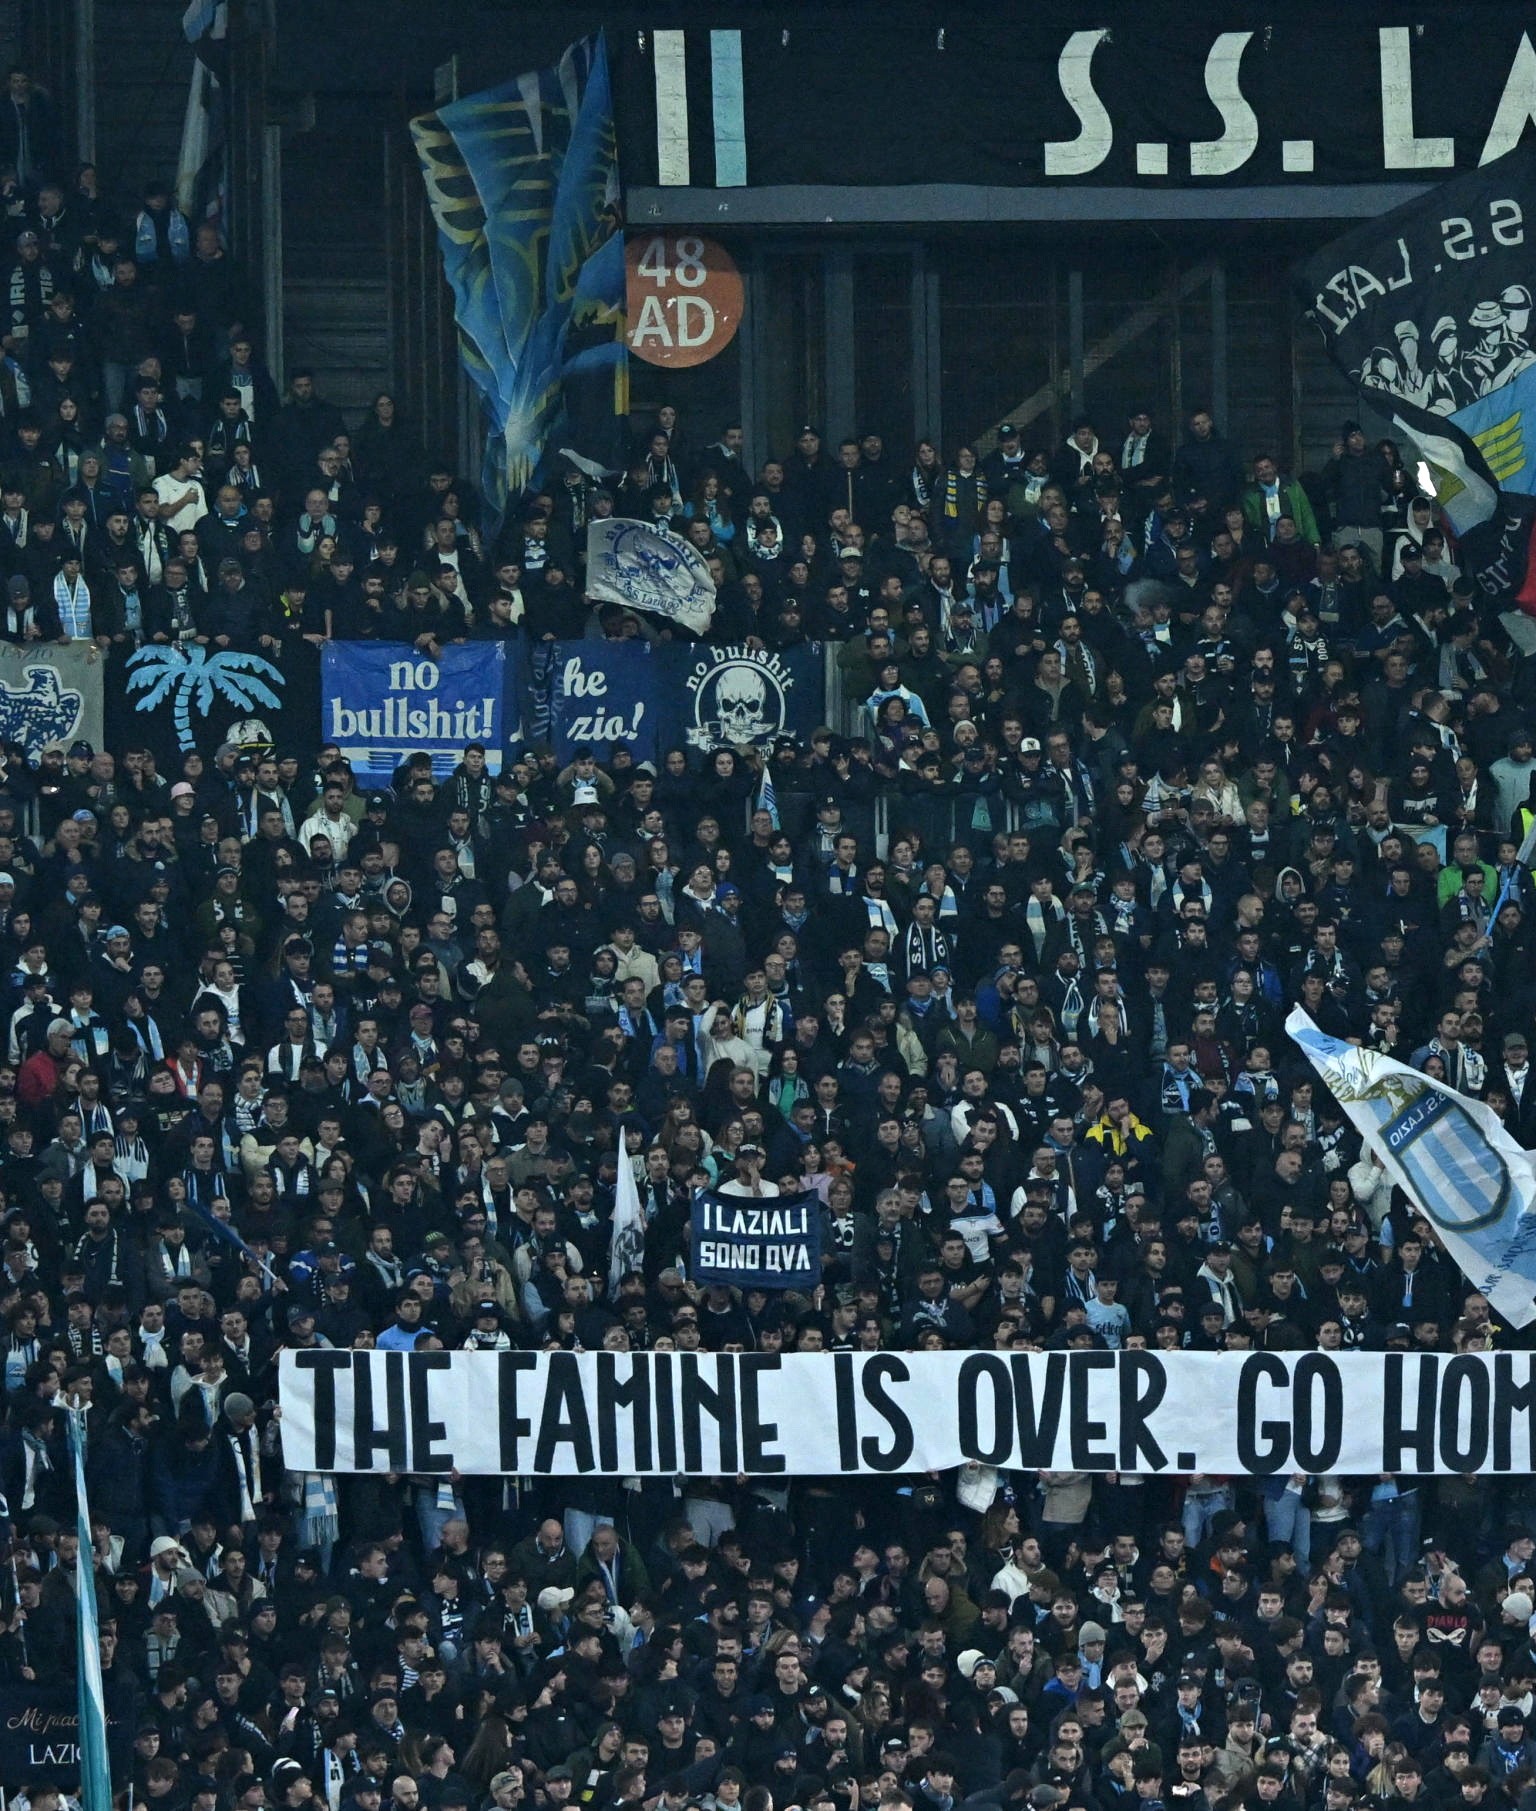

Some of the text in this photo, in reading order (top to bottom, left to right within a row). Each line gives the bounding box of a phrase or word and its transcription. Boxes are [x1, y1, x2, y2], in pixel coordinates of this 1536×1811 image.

[1045, 29, 1314, 176] S.S.
[638, 236, 706, 288] 48
[632, 295, 714, 347] AD
[389, 661, 439, 690] no
[686, 662, 707, 691] no
[331, 697, 495, 740] bullshit!
[567, 701, 645, 742] zio!
[704, 1203, 807, 1235] I LAZIALI
[700, 1241, 811, 1273] SONO QVA
[296, 1352, 453, 1473] THE
[499, 1352, 785, 1473] FAMINE
[834, 1353, 914, 1473] IS
[958, 1350, 1196, 1472] OVER.
[1237, 1352, 1342, 1475] GO
[7, 1708, 42, 1732] Mi
